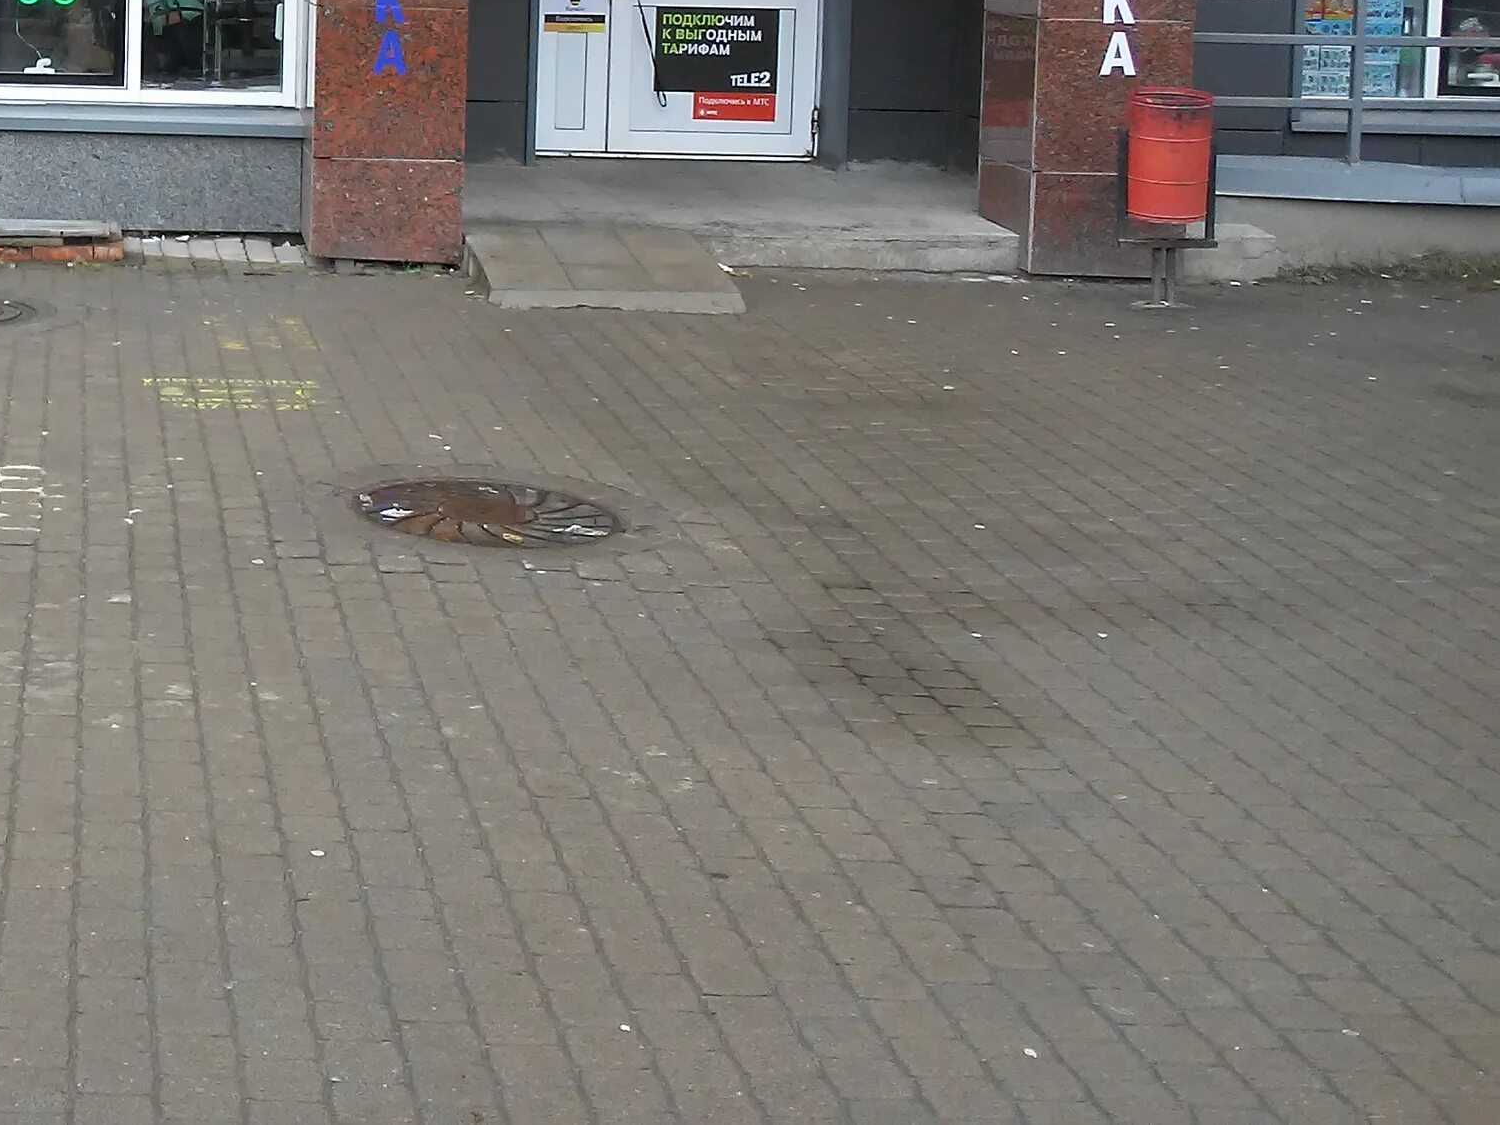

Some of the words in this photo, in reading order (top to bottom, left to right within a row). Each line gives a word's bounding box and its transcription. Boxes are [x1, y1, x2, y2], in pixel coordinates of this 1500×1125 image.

[662, 14, 755, 27] ПОДКЛЮЧИМ
[662, 28, 671, 40] К
[675, 29, 762, 42] ВЫГОДНЫМ
[662, 43, 730, 56] ТАРИФАМ
[730, 71, 771, 87] TELE2
